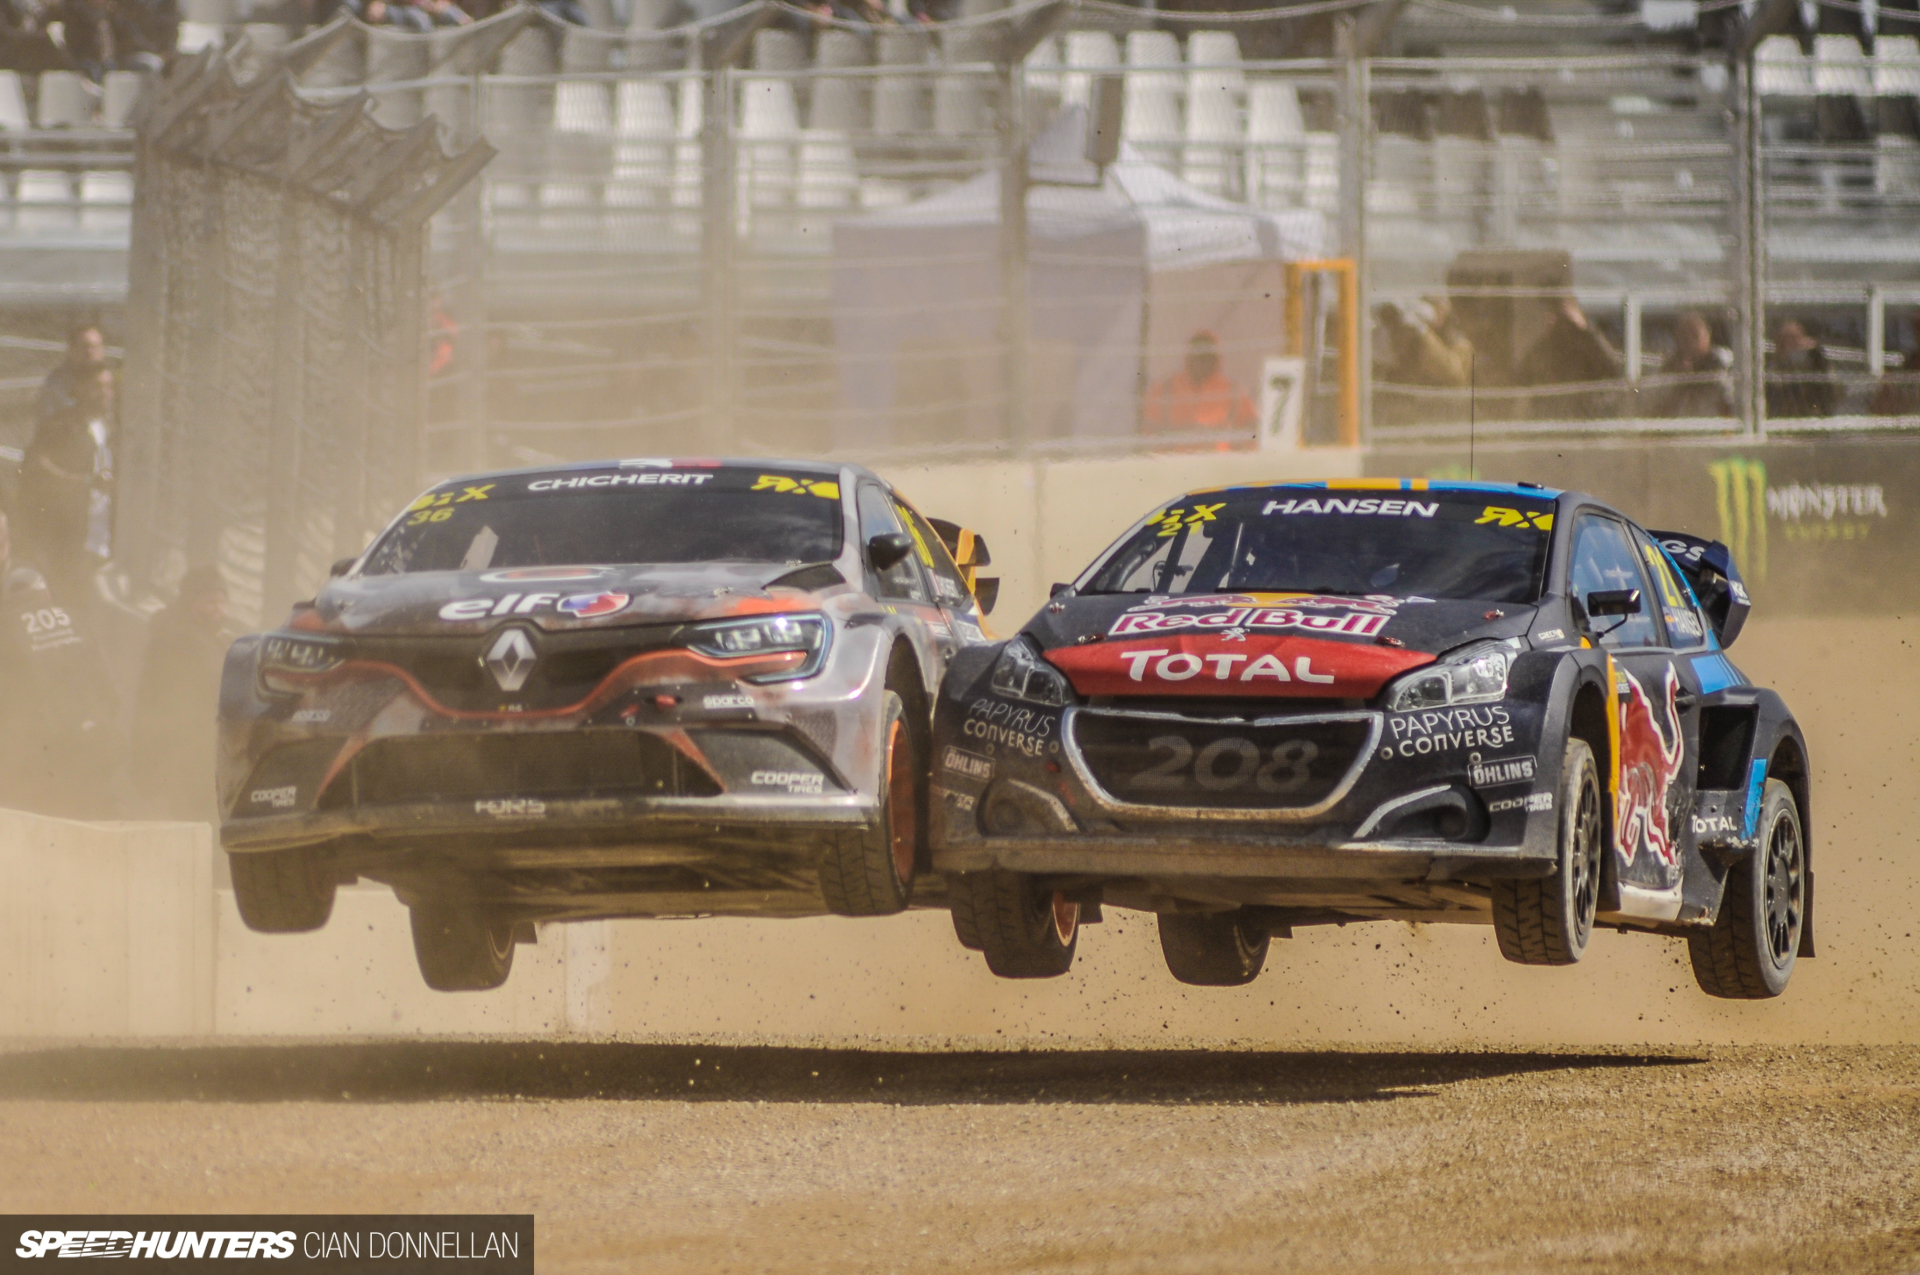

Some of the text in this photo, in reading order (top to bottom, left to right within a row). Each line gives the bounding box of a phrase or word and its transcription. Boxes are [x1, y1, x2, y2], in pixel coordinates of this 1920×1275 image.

[1269, 374, 1295, 435] 7
[528, 473, 714, 491] CHICHERIT
[1262, 499, 1440, 518] HANSEN
[1766, 480, 1888, 521] MONSTER
[406, 506, 455, 526] 36
[21, 606, 71, 634] 205
[438, 592, 561, 621] elf
[1108, 608, 1391, 636] Red Bull
[1120, 649, 1335, 684] TOTAL
[968, 698, 1056, 737] PAPYRUS
[1389, 705, 1510, 740] PAPYRUS
[963, 718, 1045, 757] CONVERSE
[1400, 725, 1515, 757] CONVERSE
[751, 770, 825, 786] COOPER
[1129, 735, 1319, 793] 208
[1473, 760, 1534, 785] ÖHLINS
[787, 784, 823, 794] TIRES
[1691, 814, 1738, 834] TOTAL
